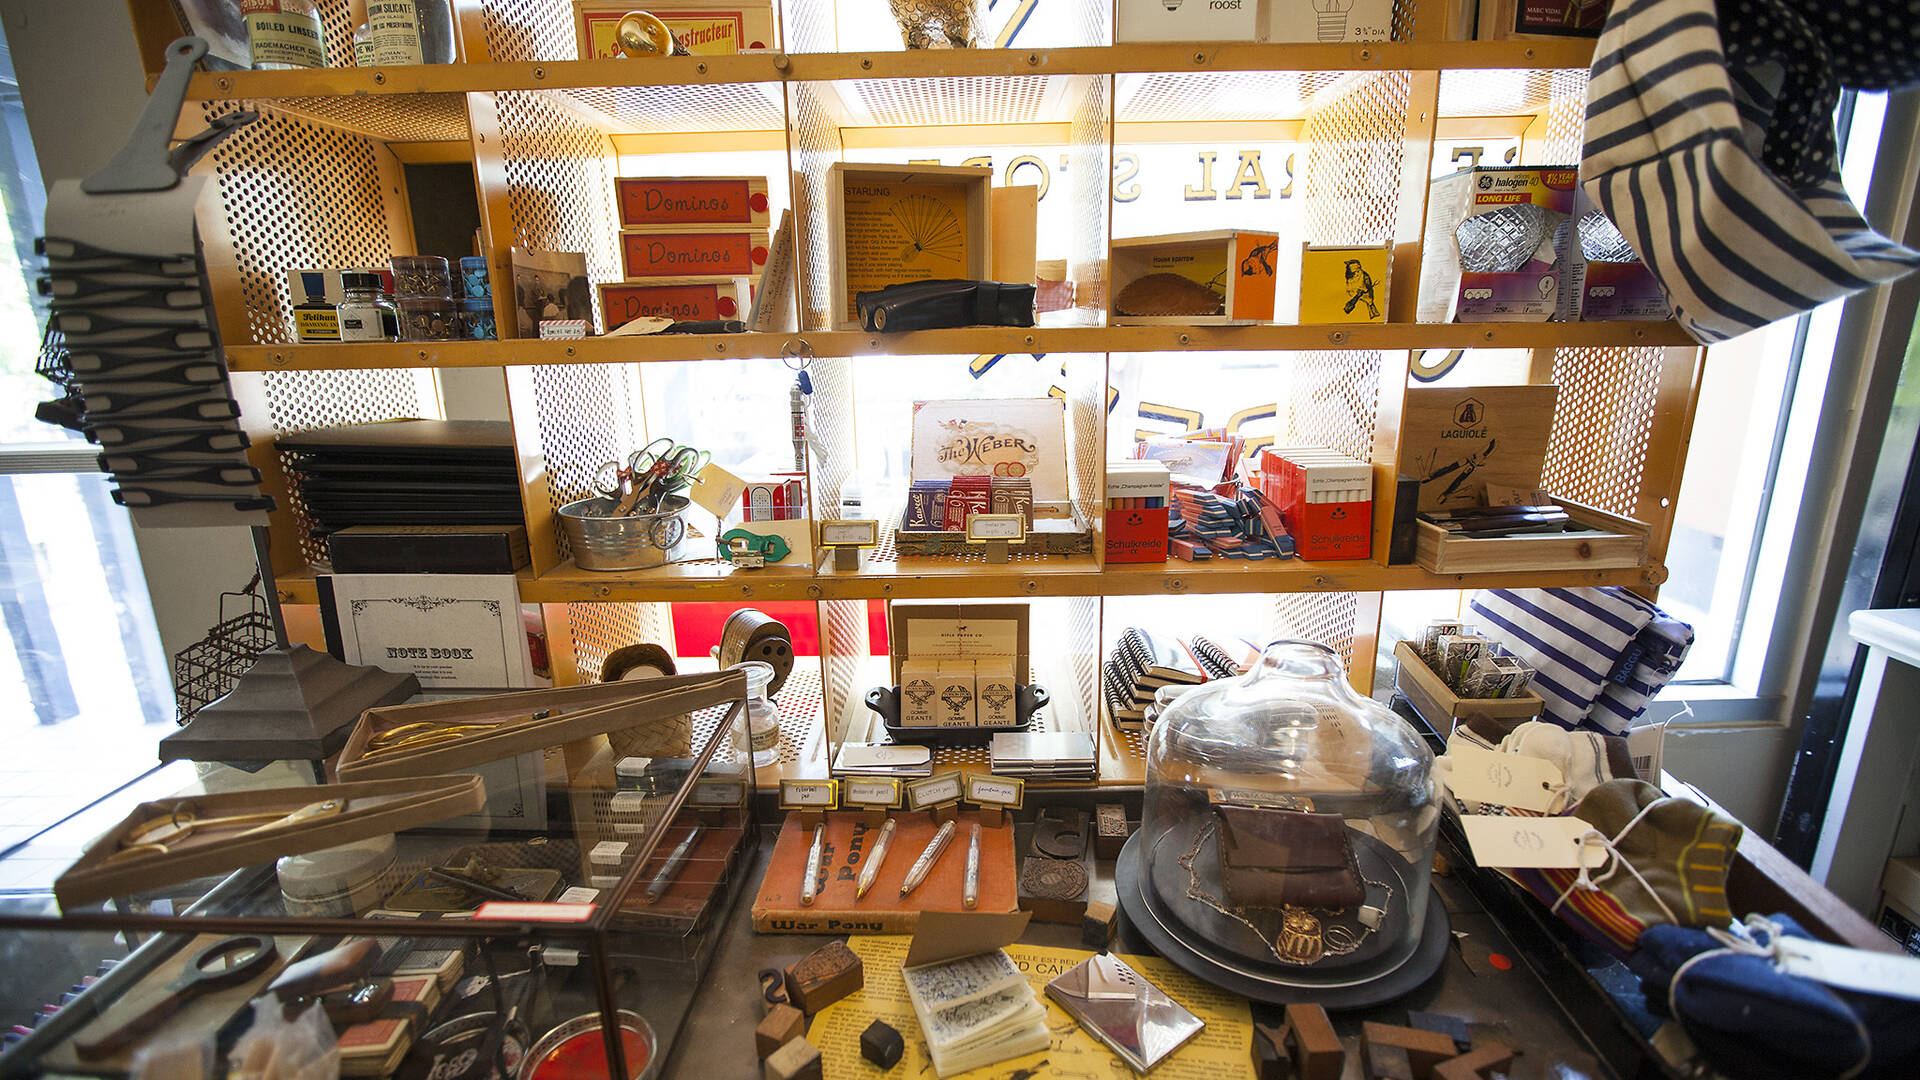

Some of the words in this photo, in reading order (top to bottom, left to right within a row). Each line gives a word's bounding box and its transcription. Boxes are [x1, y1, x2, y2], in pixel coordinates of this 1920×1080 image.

[383, 3, 412, 13] SILICATE
[1209, 0, 1241, 10] roost
[256, 22, 285, 31] BOILED
[1495, 177, 1528, 188] halogen
[1529, 176, 1540, 186] 40
[844, 187, 890, 197] STARLING
[643, 188, 729, 212] Dominos
[1477, 194, 1502, 203] LONG
[1503, 194, 1521, 202] LIFE
[647, 241, 731, 264] Dominos
[624, 295, 700, 319] Dominos
[302, 313, 336, 321] Pelikan
[1106, 539, 1162, 549] Schulkreide
[386, 647, 428, 659] NOTE
[429, 648, 474, 660] BOOK
[1614, 649, 1642, 684] BAGGU
[836, 822, 870, 881] Pony
[771, 920, 818, 929] War
[828, 920, 883, 931] Pony
